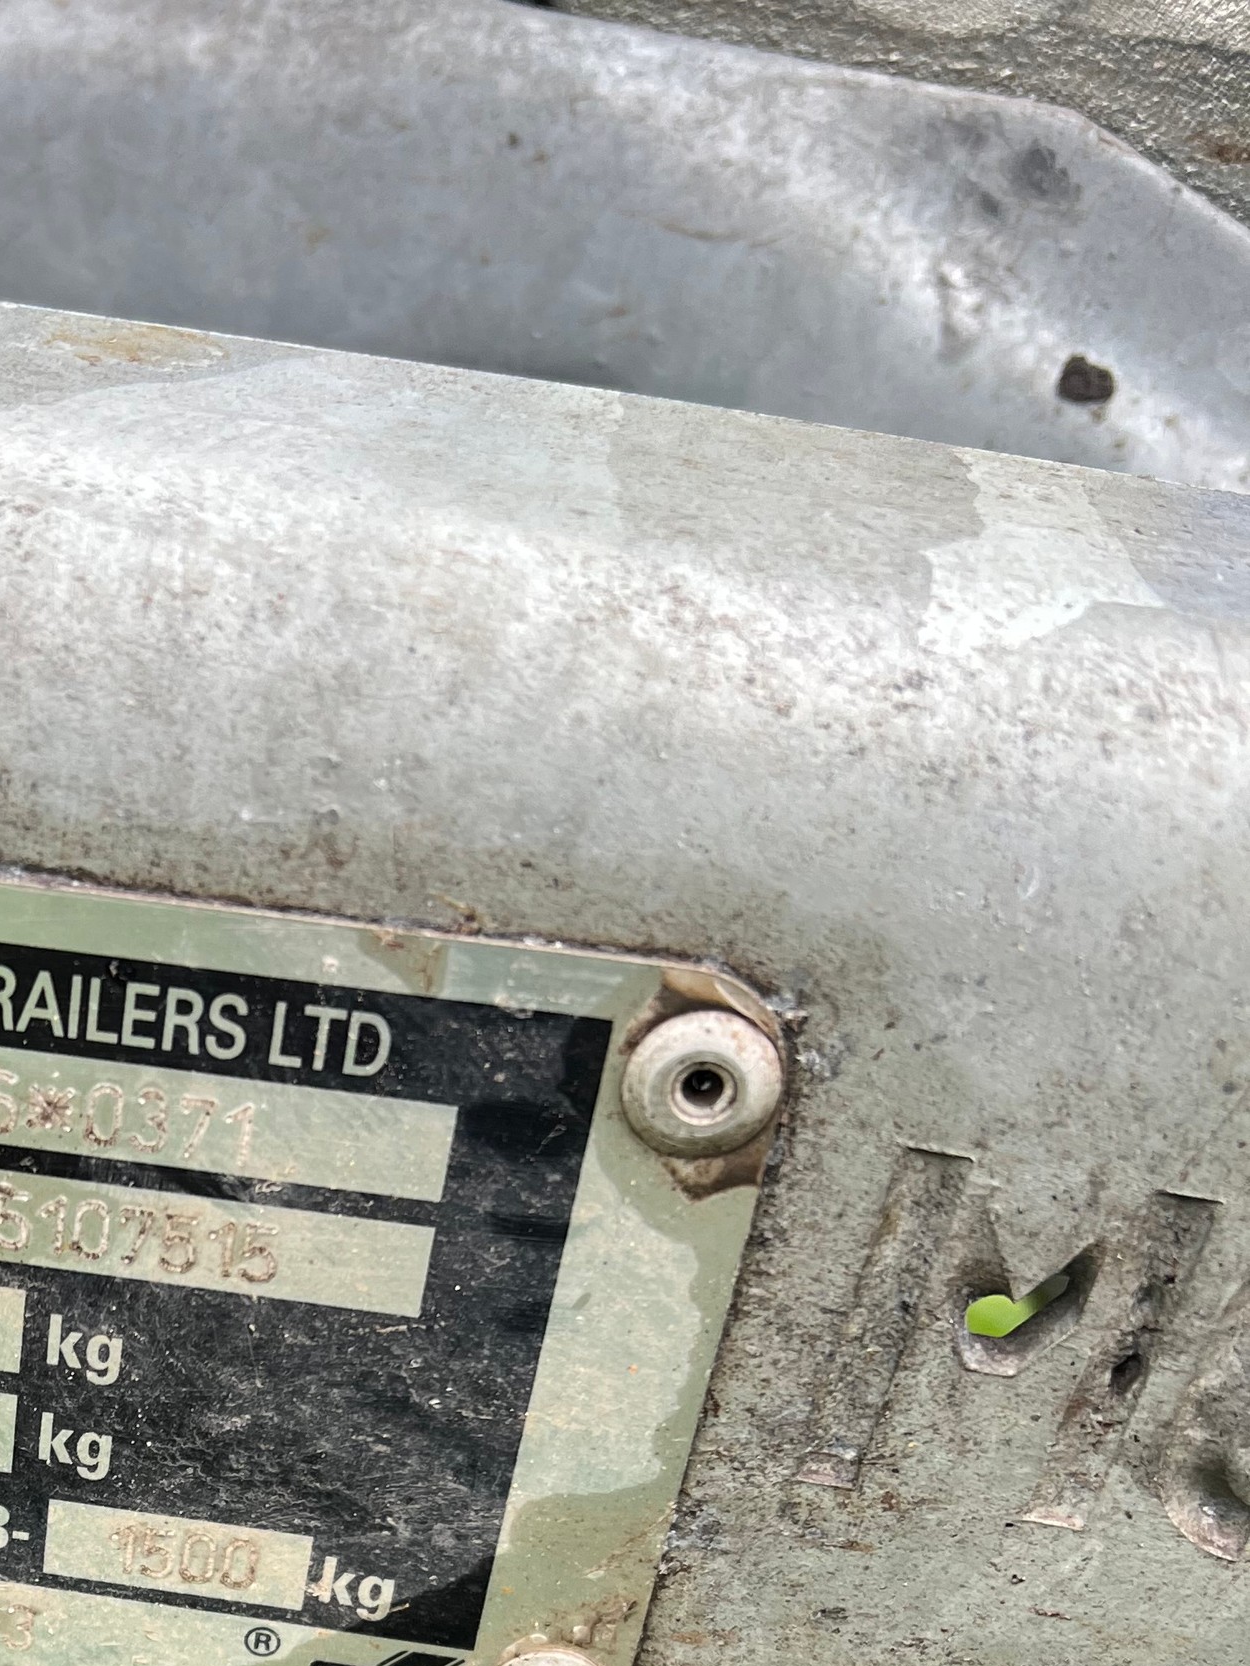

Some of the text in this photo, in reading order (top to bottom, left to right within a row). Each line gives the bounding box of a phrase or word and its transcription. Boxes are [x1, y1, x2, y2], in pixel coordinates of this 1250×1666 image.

[267, 1001, 393, 1078] LTD
[45, 1313, 124, 1386] kg
[37, 1411, 113, 1481] kg
[107, 1521, 261, 1591] 1500
[316, 1555, 398, 1623] kg
